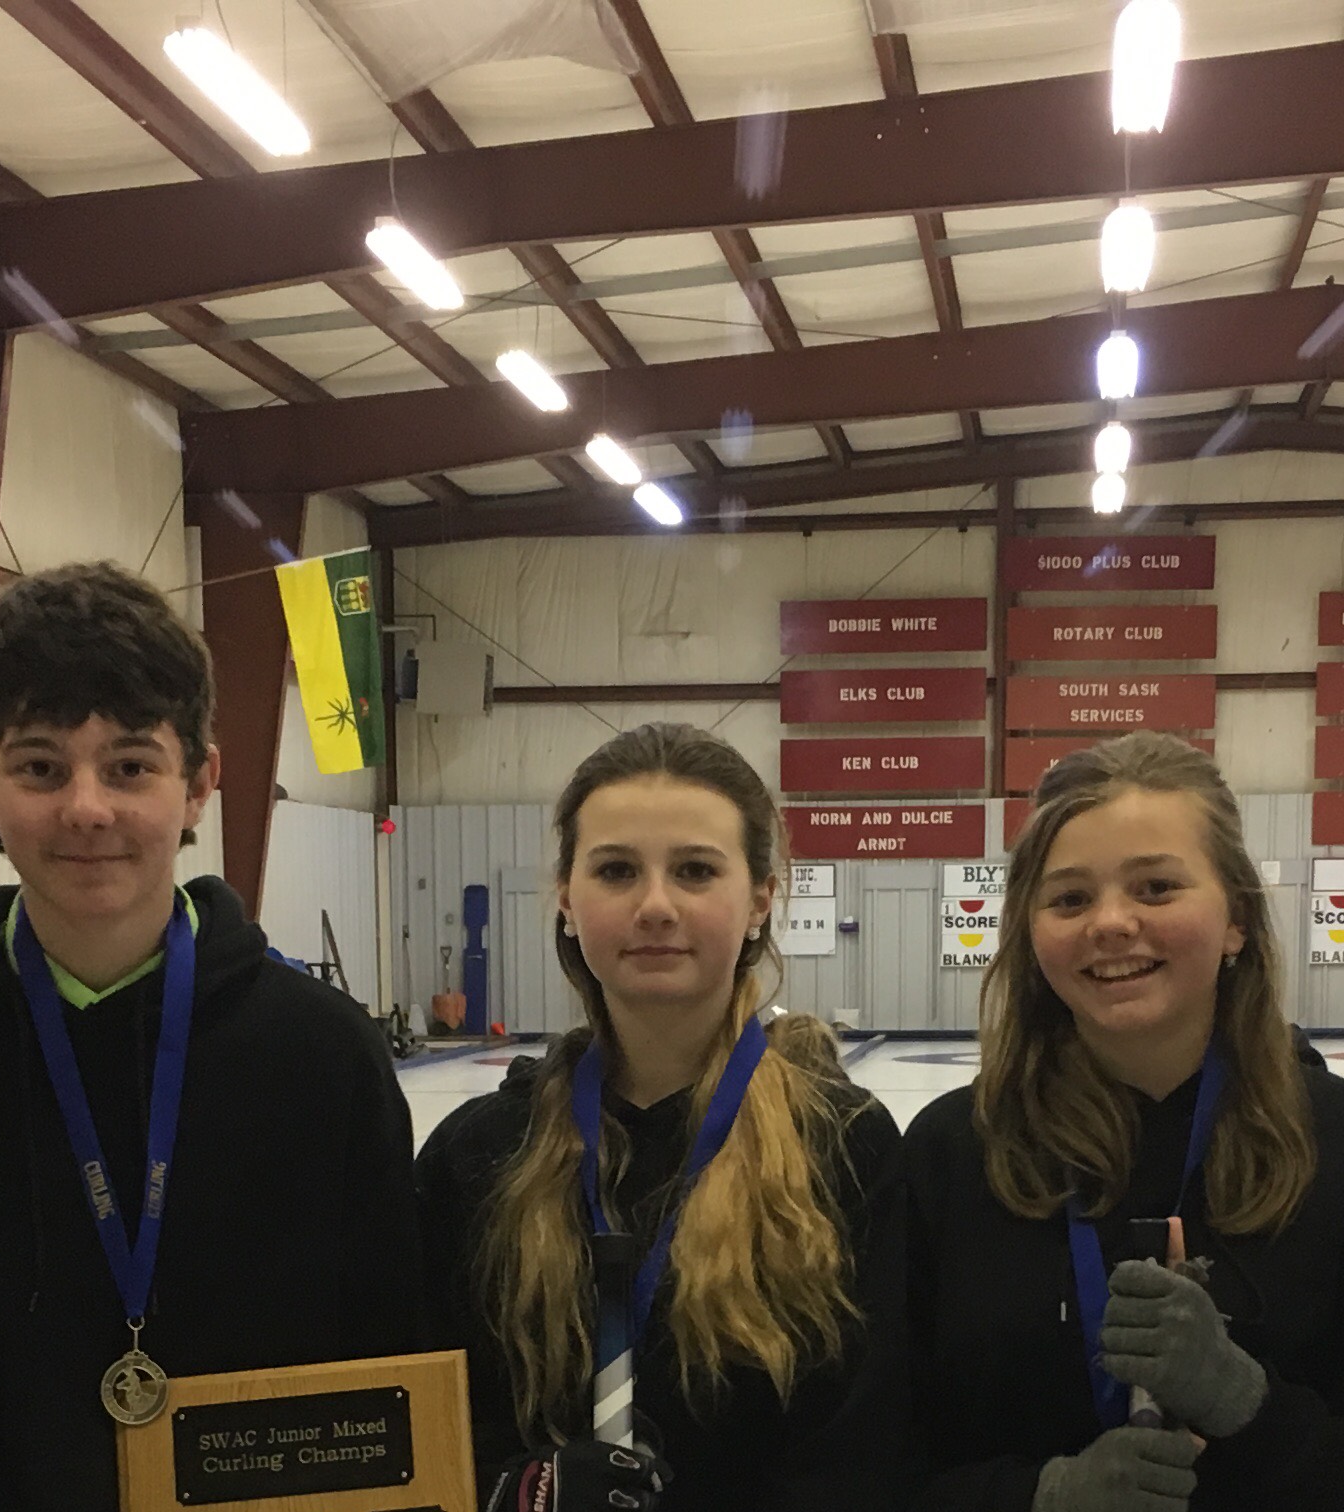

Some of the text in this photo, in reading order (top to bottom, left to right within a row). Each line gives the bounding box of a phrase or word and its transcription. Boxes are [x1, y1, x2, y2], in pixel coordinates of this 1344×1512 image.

[1038, 555, 1180, 570] $1000 PLUS CLUB
[828, 617, 937, 633] BOBBIE WHITE
[1053, 627, 1163, 641] ROTARY CLUB
[839, 687, 925, 701] ELKS CLUB
[1059, 683, 1160, 697] SOUTH SASK
[1070, 709, 1144, 722] SERVICES
[842, 756, 919, 770] KEN CLUB
[810, 811, 953, 825] NORM AND DULCIE
[857, 838, 906, 851] ARNDT
[944, 916, 998, 928] SCORE
[199, 1417, 387, 1451] SWAC Junior Mixed
[203, 1444, 386, 1473] Curling Champs
